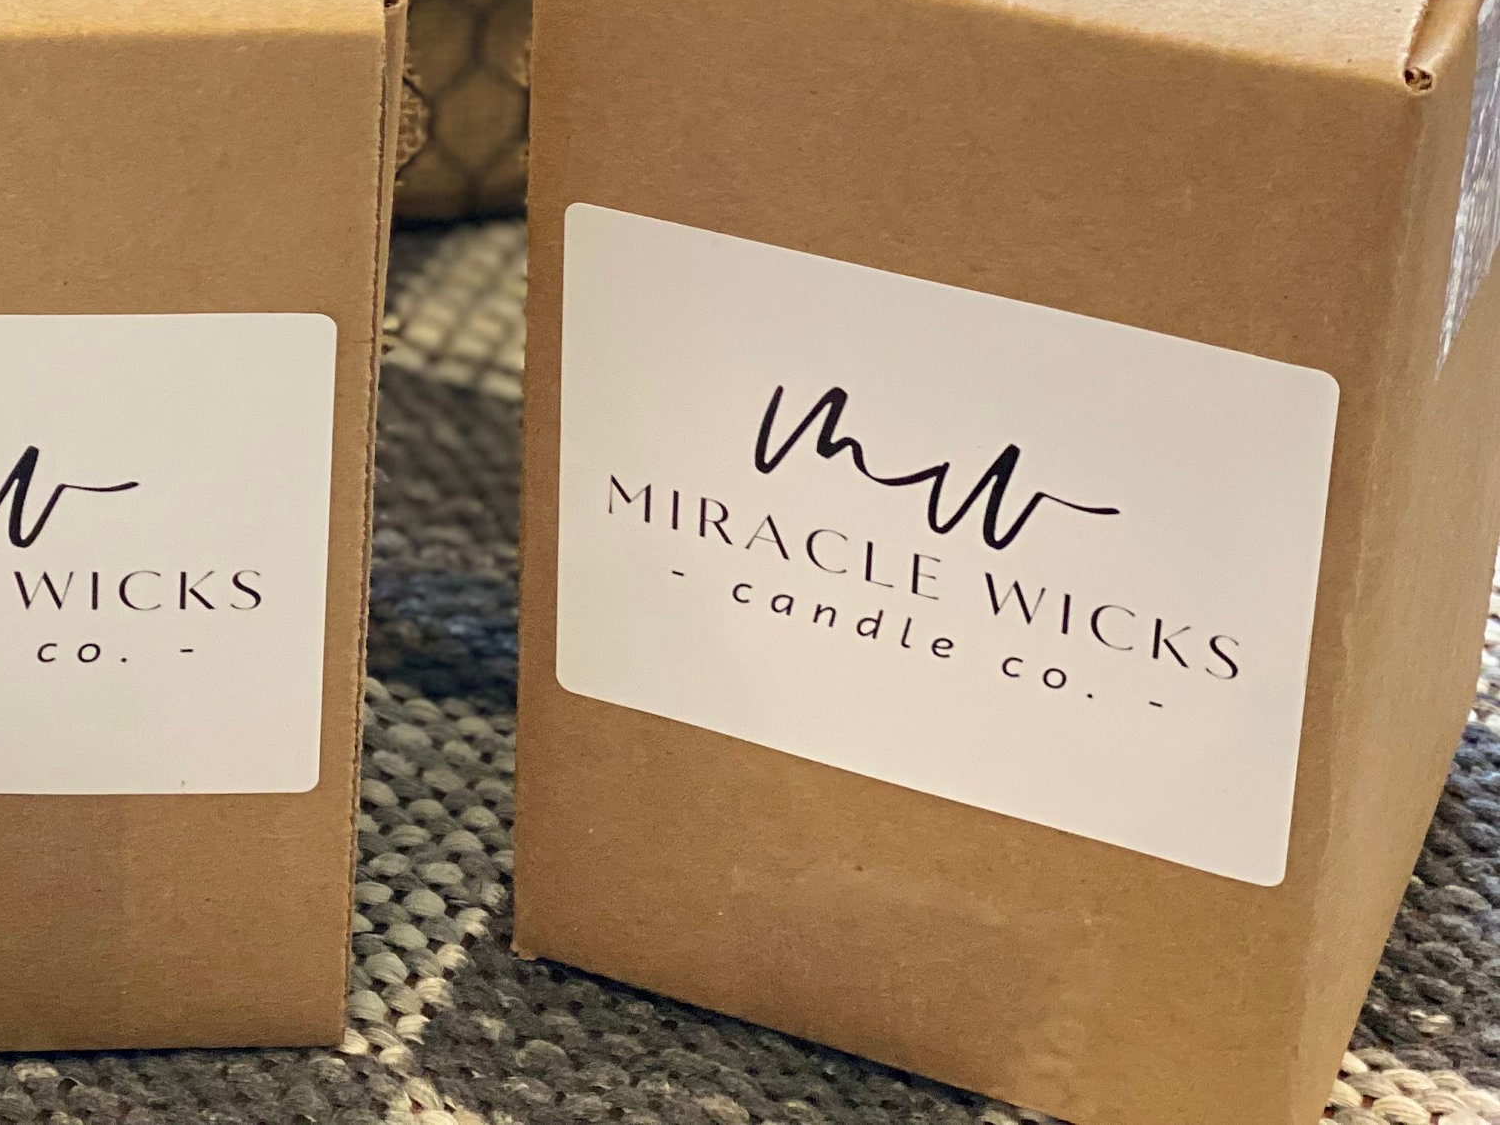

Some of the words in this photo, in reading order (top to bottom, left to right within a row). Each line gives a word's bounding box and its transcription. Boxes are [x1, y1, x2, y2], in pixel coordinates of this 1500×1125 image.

[13, 569, 264, 613] WICKS
[607, 473, 943, 603] MIRACLE
[983, 570, 1244, 684] WICKS
[37, 641, 130, 665] co.
[731, 582, 957, 663] candle
[1001, 655, 1095, 701] co.
